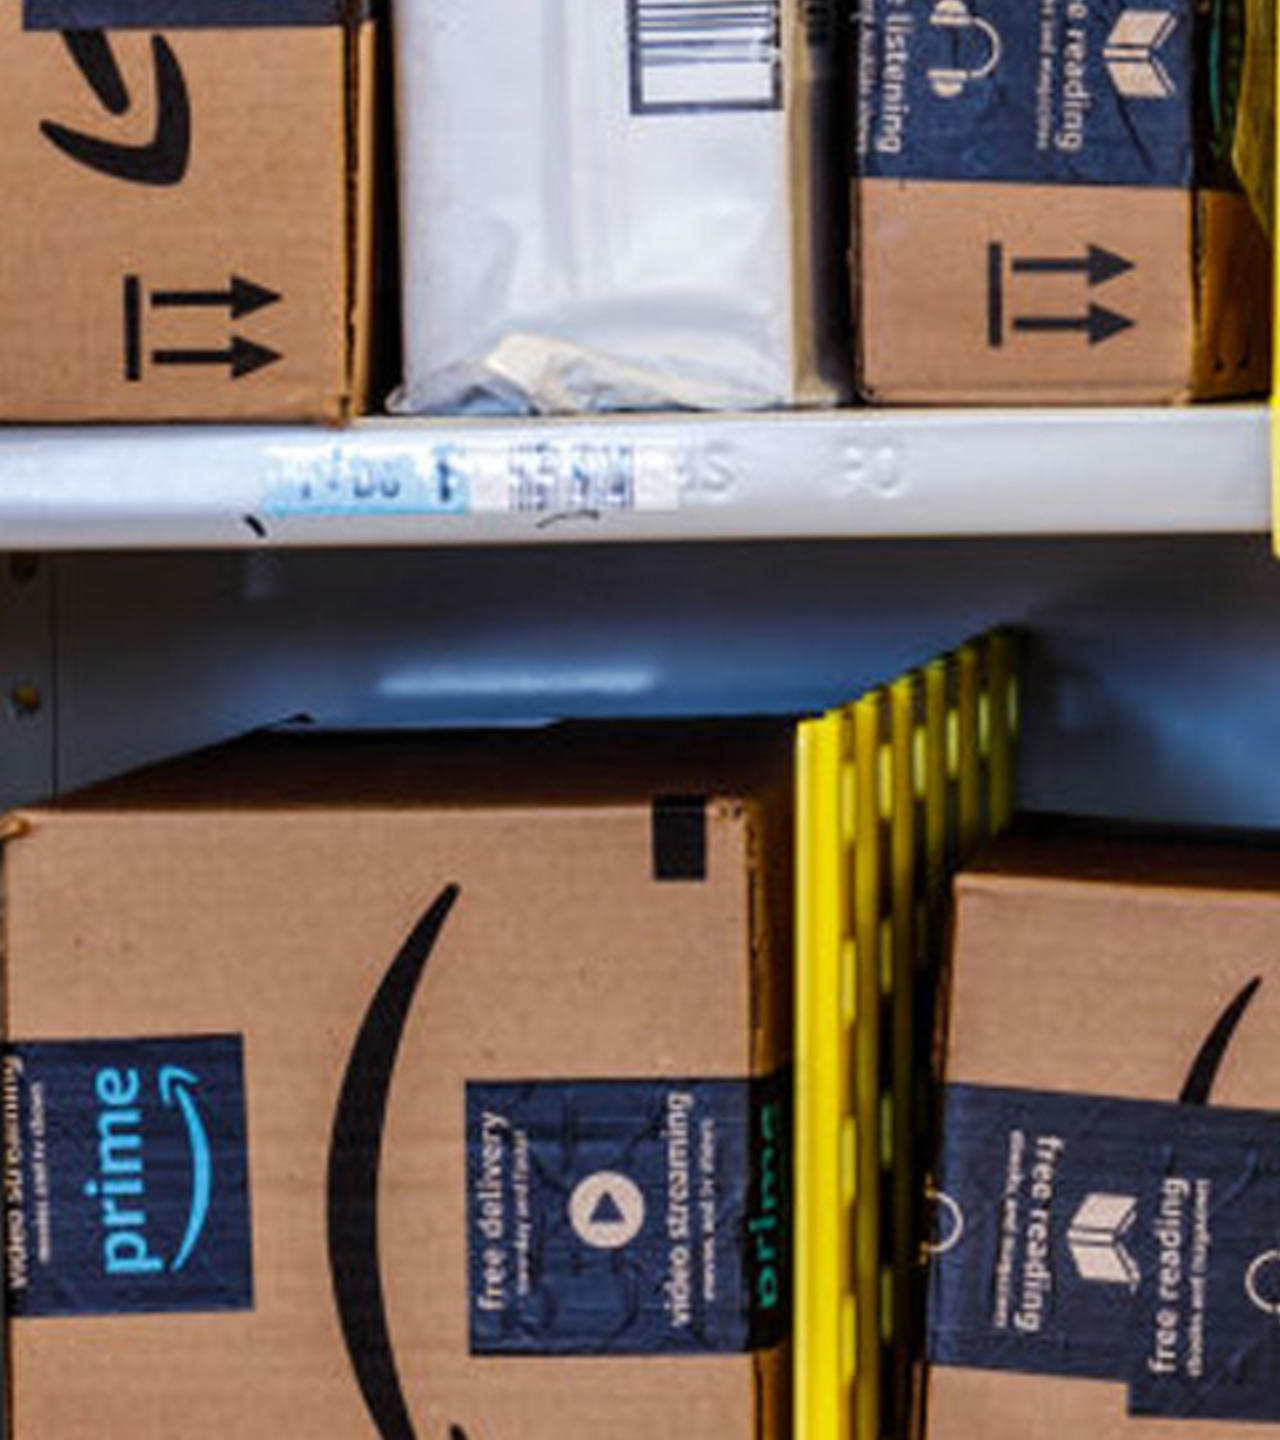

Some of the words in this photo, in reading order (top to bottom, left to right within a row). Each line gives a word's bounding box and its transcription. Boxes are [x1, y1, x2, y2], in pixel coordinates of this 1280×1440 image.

[878, 14, 913, 153] listening
[1058, 29, 1090, 151] reading
[83, 1067, 164, 1275] prime
[477, 1112, 509, 1238] delivery
[661, 1092, 694, 1238] streaming
[1032, 1134, 1063, 1201] free
[7, 1210, 27, 1289] video
[478, 1249, 504, 1310] free
[663, 1246, 691, 1327] video
[1015, 1208, 1052, 1332] reading
[1153, 1176, 1189, 1300] reading
[1149, 1309, 1178, 1374] free
